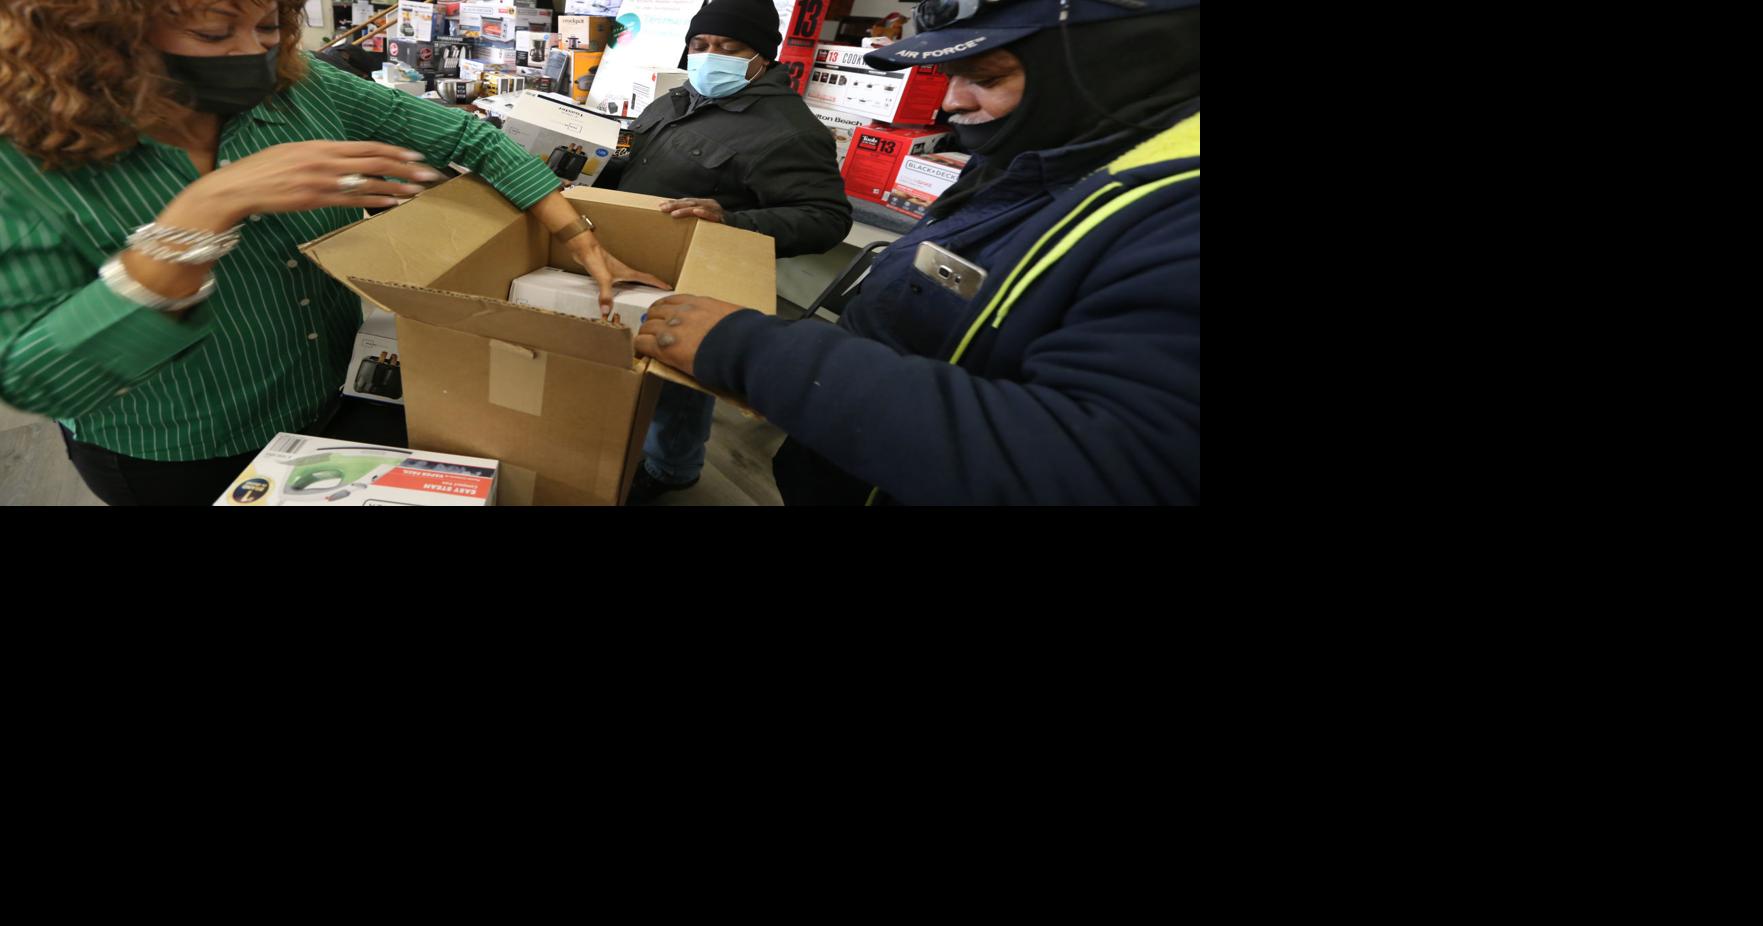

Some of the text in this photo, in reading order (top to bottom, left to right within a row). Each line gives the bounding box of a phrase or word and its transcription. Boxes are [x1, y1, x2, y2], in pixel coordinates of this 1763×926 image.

[793, 0, 823, 37] 13
[828, 51, 839, 63] 13
[895, 49, 919, 59] AIR
[834, 116, 863, 126] Beach
[879, 140, 896, 154] 13
